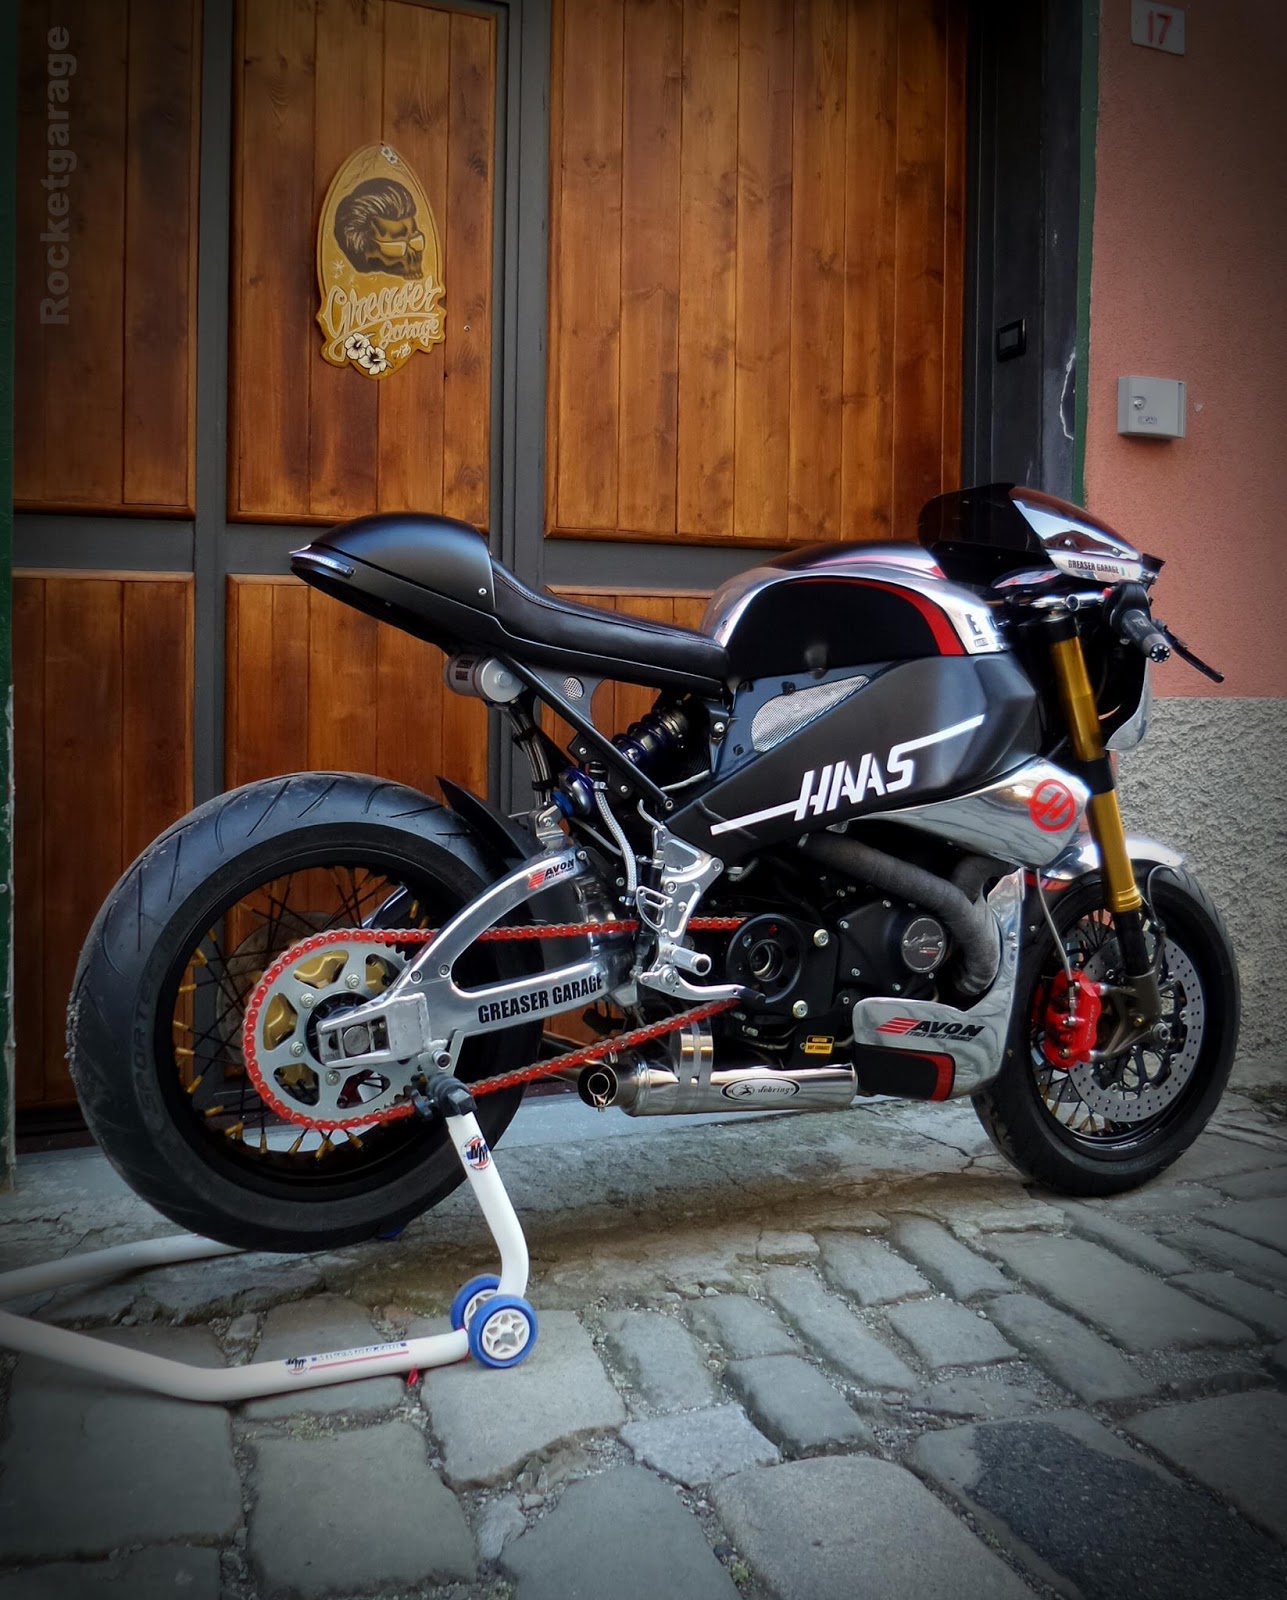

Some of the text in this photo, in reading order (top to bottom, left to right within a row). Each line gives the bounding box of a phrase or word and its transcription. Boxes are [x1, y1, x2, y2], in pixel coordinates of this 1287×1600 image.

[1147, 11, 1173, 45] 17
[323, 276, 441, 361] Greaser
[1068, 560, 1119, 573] GREASER GARAGE
[546, 858, 575, 877] AVON
[477, 973, 603, 1023] GREASER GARAGE
[910, 1020, 985, 1037] AVON
